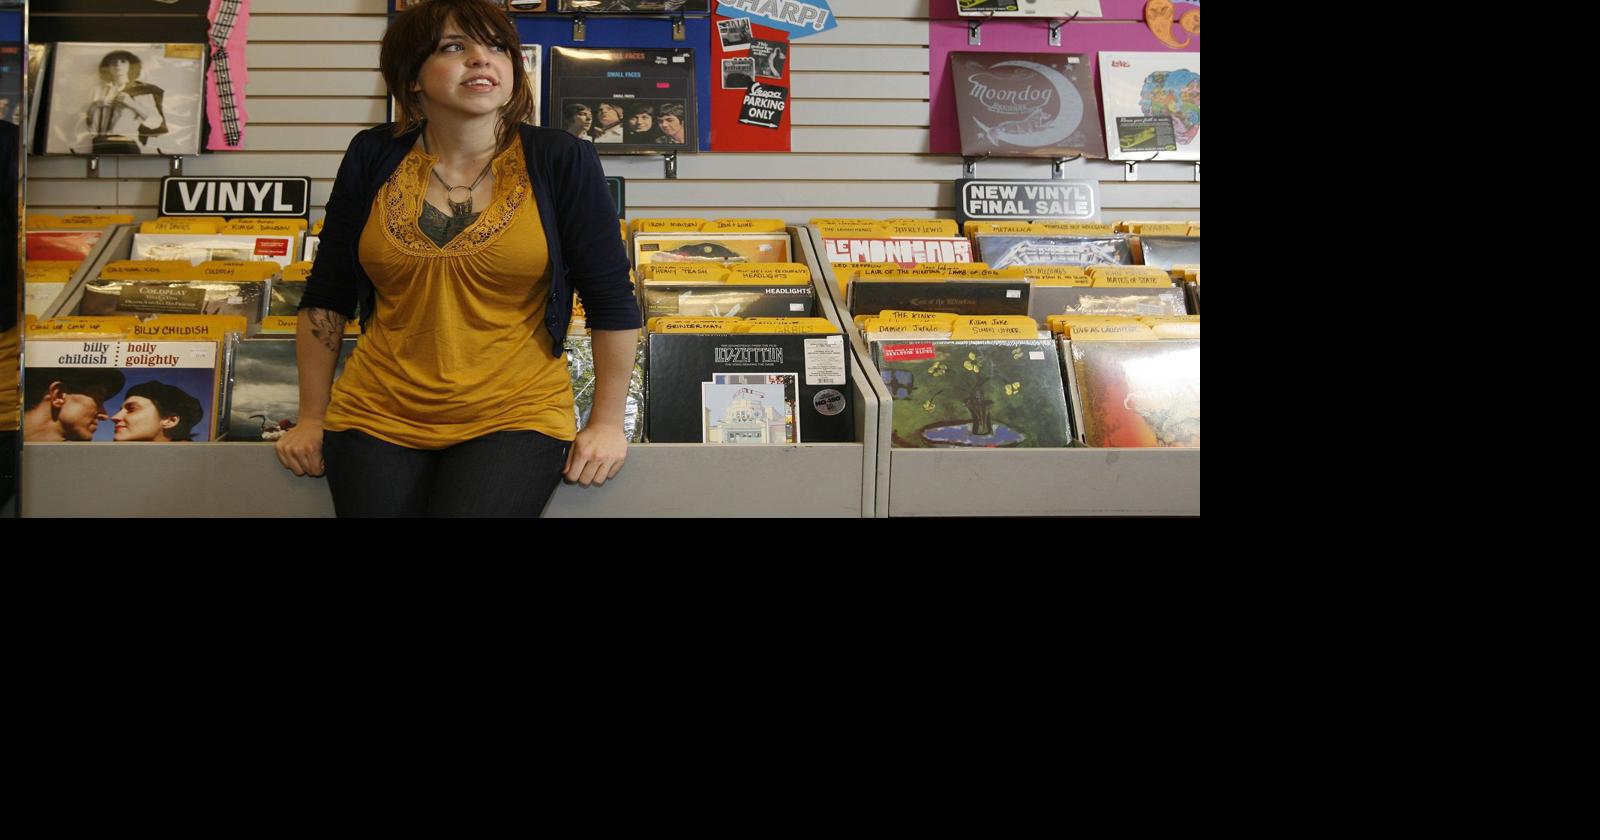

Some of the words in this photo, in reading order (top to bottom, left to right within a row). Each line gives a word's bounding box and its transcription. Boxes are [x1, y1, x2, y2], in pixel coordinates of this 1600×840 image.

[743, 95, 785, 111] PARKING
[748, 108, 775, 120] ONLY
[178, 181, 293, 212] VINYL
[970, 185, 1018, 200] NEW
[1024, 186, 1086, 200] VINYL
[969, 200, 1030, 215] FINAL
[1035, 202, 1089, 215] SALE
[134, 326, 160, 335] BILLY
[162, 325, 209, 335] CHILDISH
[83, 342, 110, 353] billy
[127, 343, 157, 354] holly
[58, 354, 107, 365] childish
[125, 354, 180, 367] golightly
